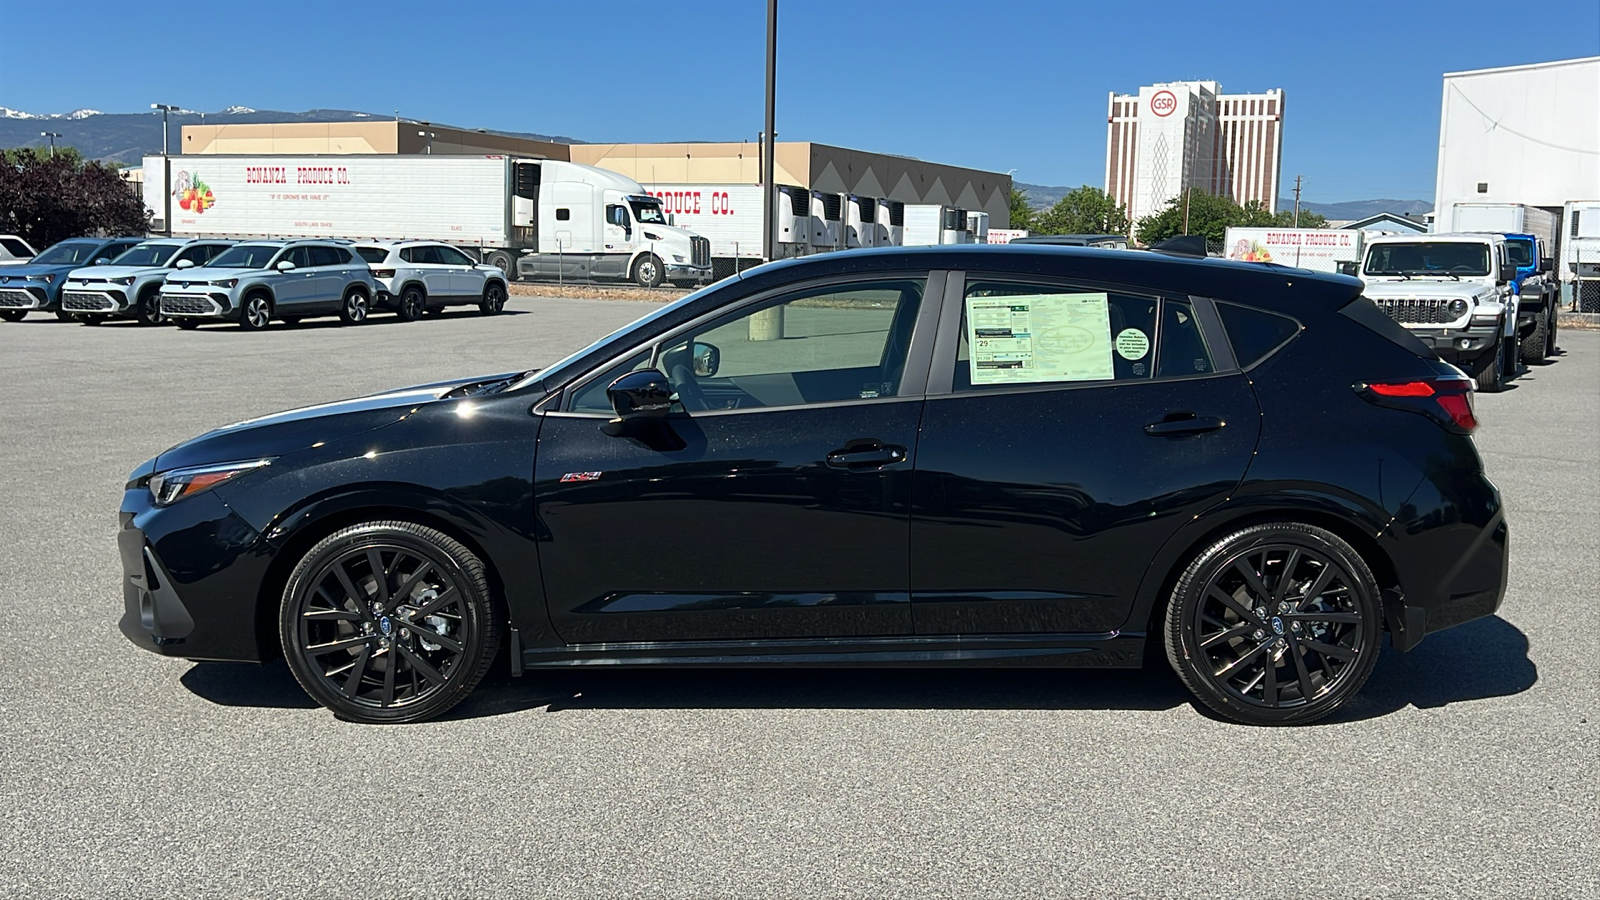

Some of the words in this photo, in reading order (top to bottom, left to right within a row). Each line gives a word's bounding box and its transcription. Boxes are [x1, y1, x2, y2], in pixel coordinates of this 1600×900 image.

[1154, 98, 1173, 109] GSR
[246, 167, 286, 183] BONANZA
[297, 167, 333, 184] PRODUCE
[337, 167, 350, 184] CO.
[646, 191, 701, 214] ODUCE
[712, 192, 734, 215] CO.
[1266, 233, 1302, 245] BONANZA
[1305, 234, 1338, 246] PRODUCE
[1340, 234, 1351, 246] CO.
